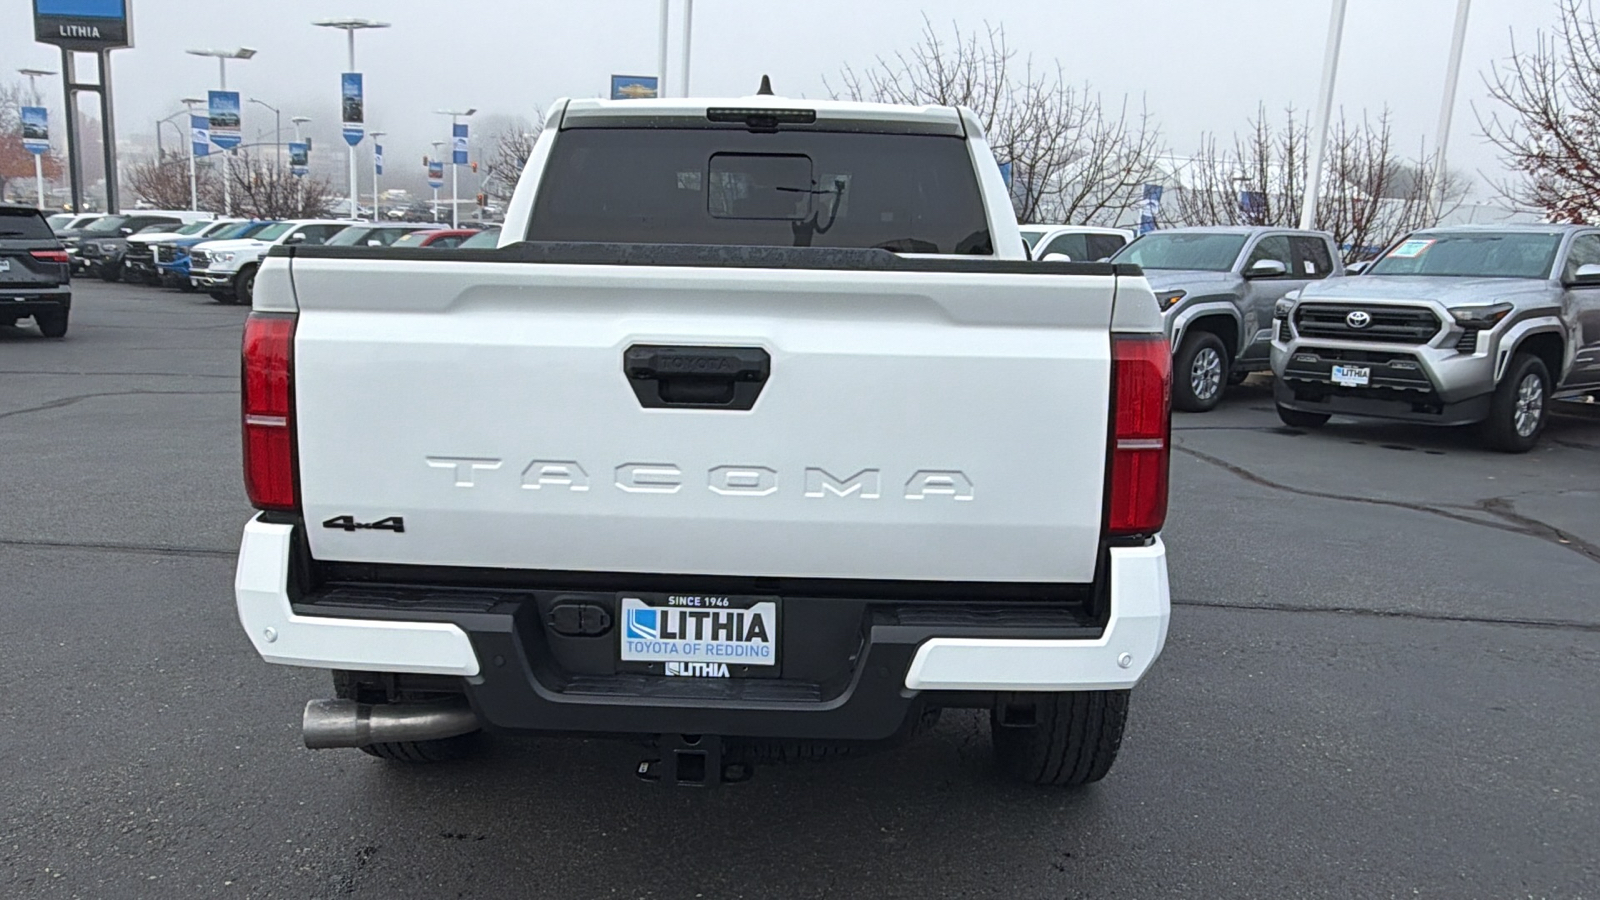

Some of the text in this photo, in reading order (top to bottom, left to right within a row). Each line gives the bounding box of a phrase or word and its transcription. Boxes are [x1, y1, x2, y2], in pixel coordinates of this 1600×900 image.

[60, 25, 100, 38] LITHIA
[661, 357, 731, 371] TOYOTA
[1341, 368, 1368, 378] LITHIA
[426, 456, 974, 501] TACOMA
[668, 595, 729, 607] SINCE 1946
[660, 610, 769, 643] LITHIA
[627, 641, 770, 657] TOYOTA OF REDDING
[680, 662, 730, 678] LITHIA
